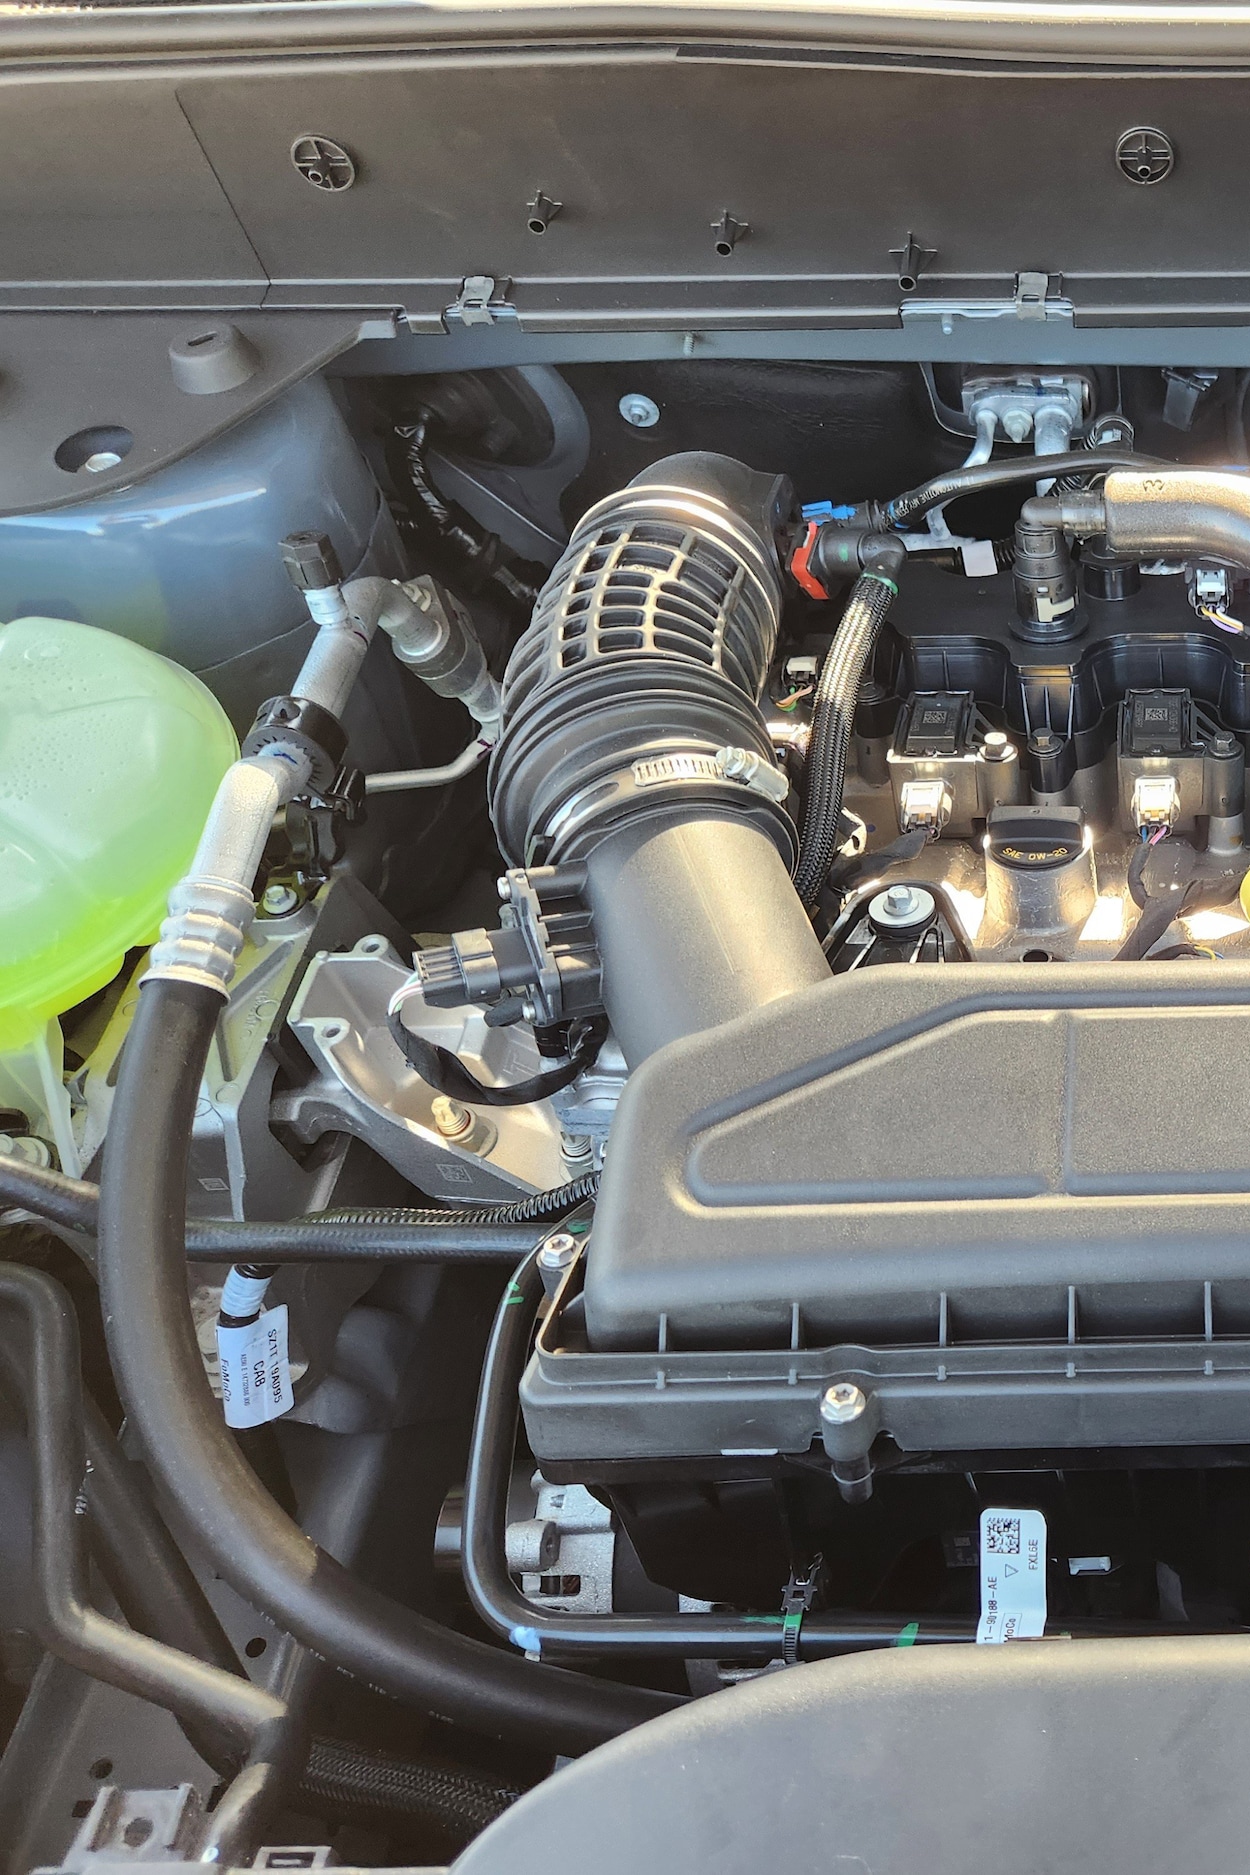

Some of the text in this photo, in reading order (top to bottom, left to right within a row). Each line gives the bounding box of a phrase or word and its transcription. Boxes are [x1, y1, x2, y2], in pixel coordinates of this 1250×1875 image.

[1003, 847, 1068, 861] SAE 0W-20
[221, 1358, 232, 1402] FoMoCo
[253, 1360, 266, 1388] CAB
[267, 1329, 283, 1404] SZ1T 19A095
[1028, 1539, 1038, 1571] FXL6E
